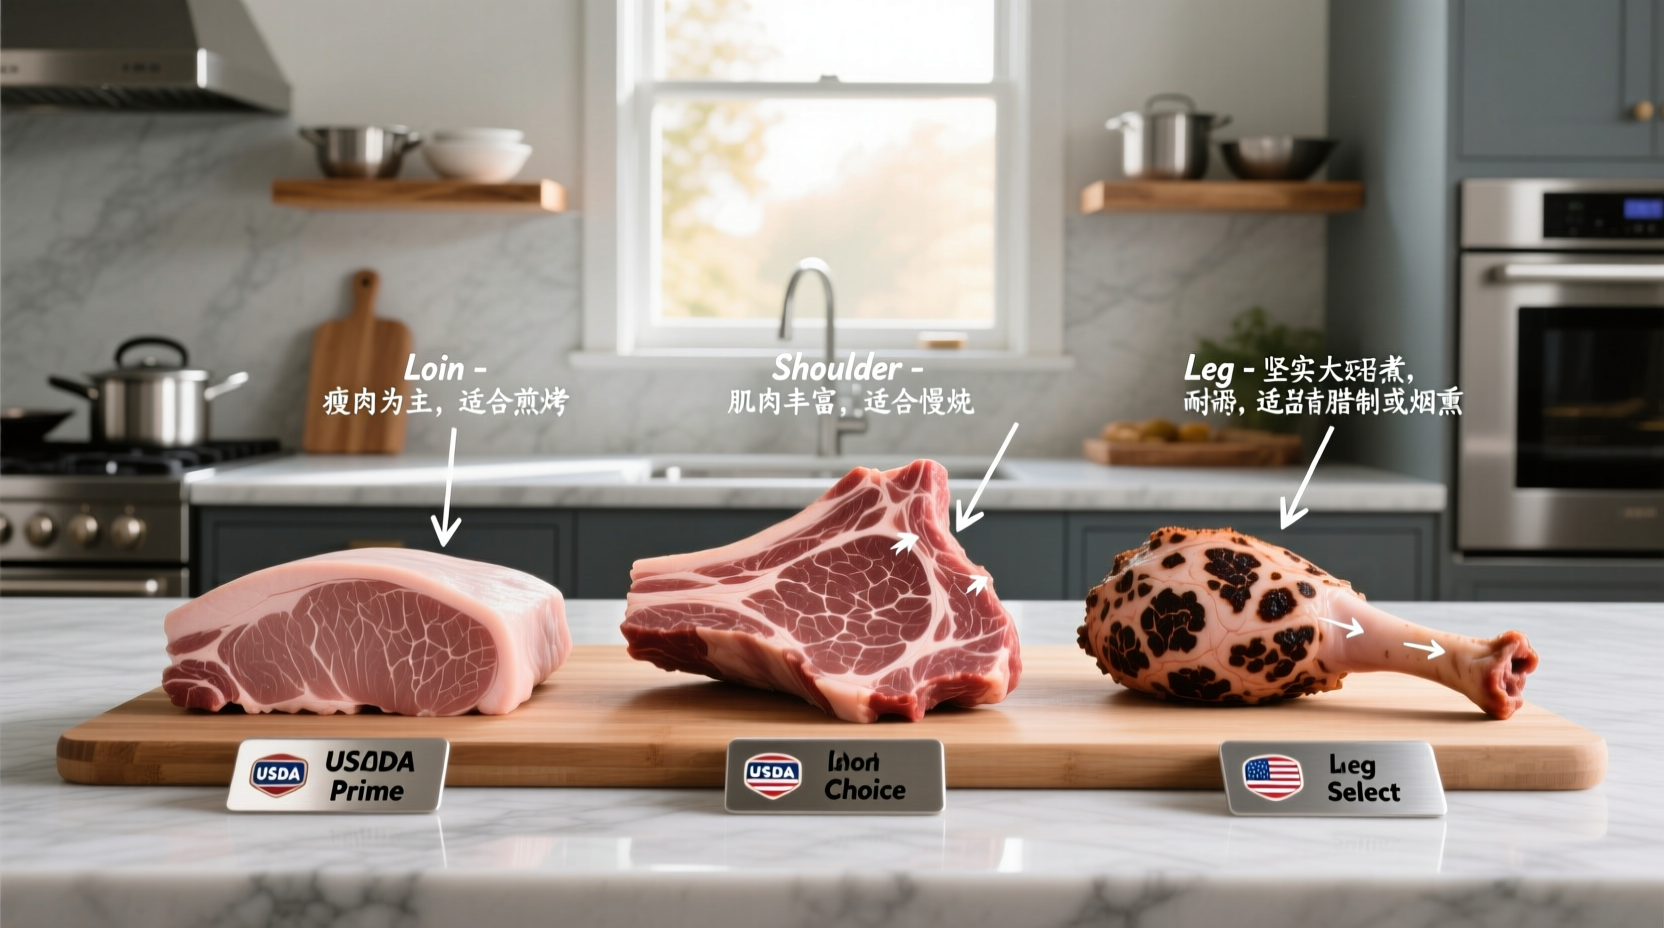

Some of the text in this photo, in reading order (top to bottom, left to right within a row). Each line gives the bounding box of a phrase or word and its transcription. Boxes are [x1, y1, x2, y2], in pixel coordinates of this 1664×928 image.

[256, 766, 300, 781] USDA
[750, 766, 795, 779] USDA
[330, 779, 405, 801] Prime
[824, 777, 907, 800] Choice
[1327, 780, 1401, 802] Select
